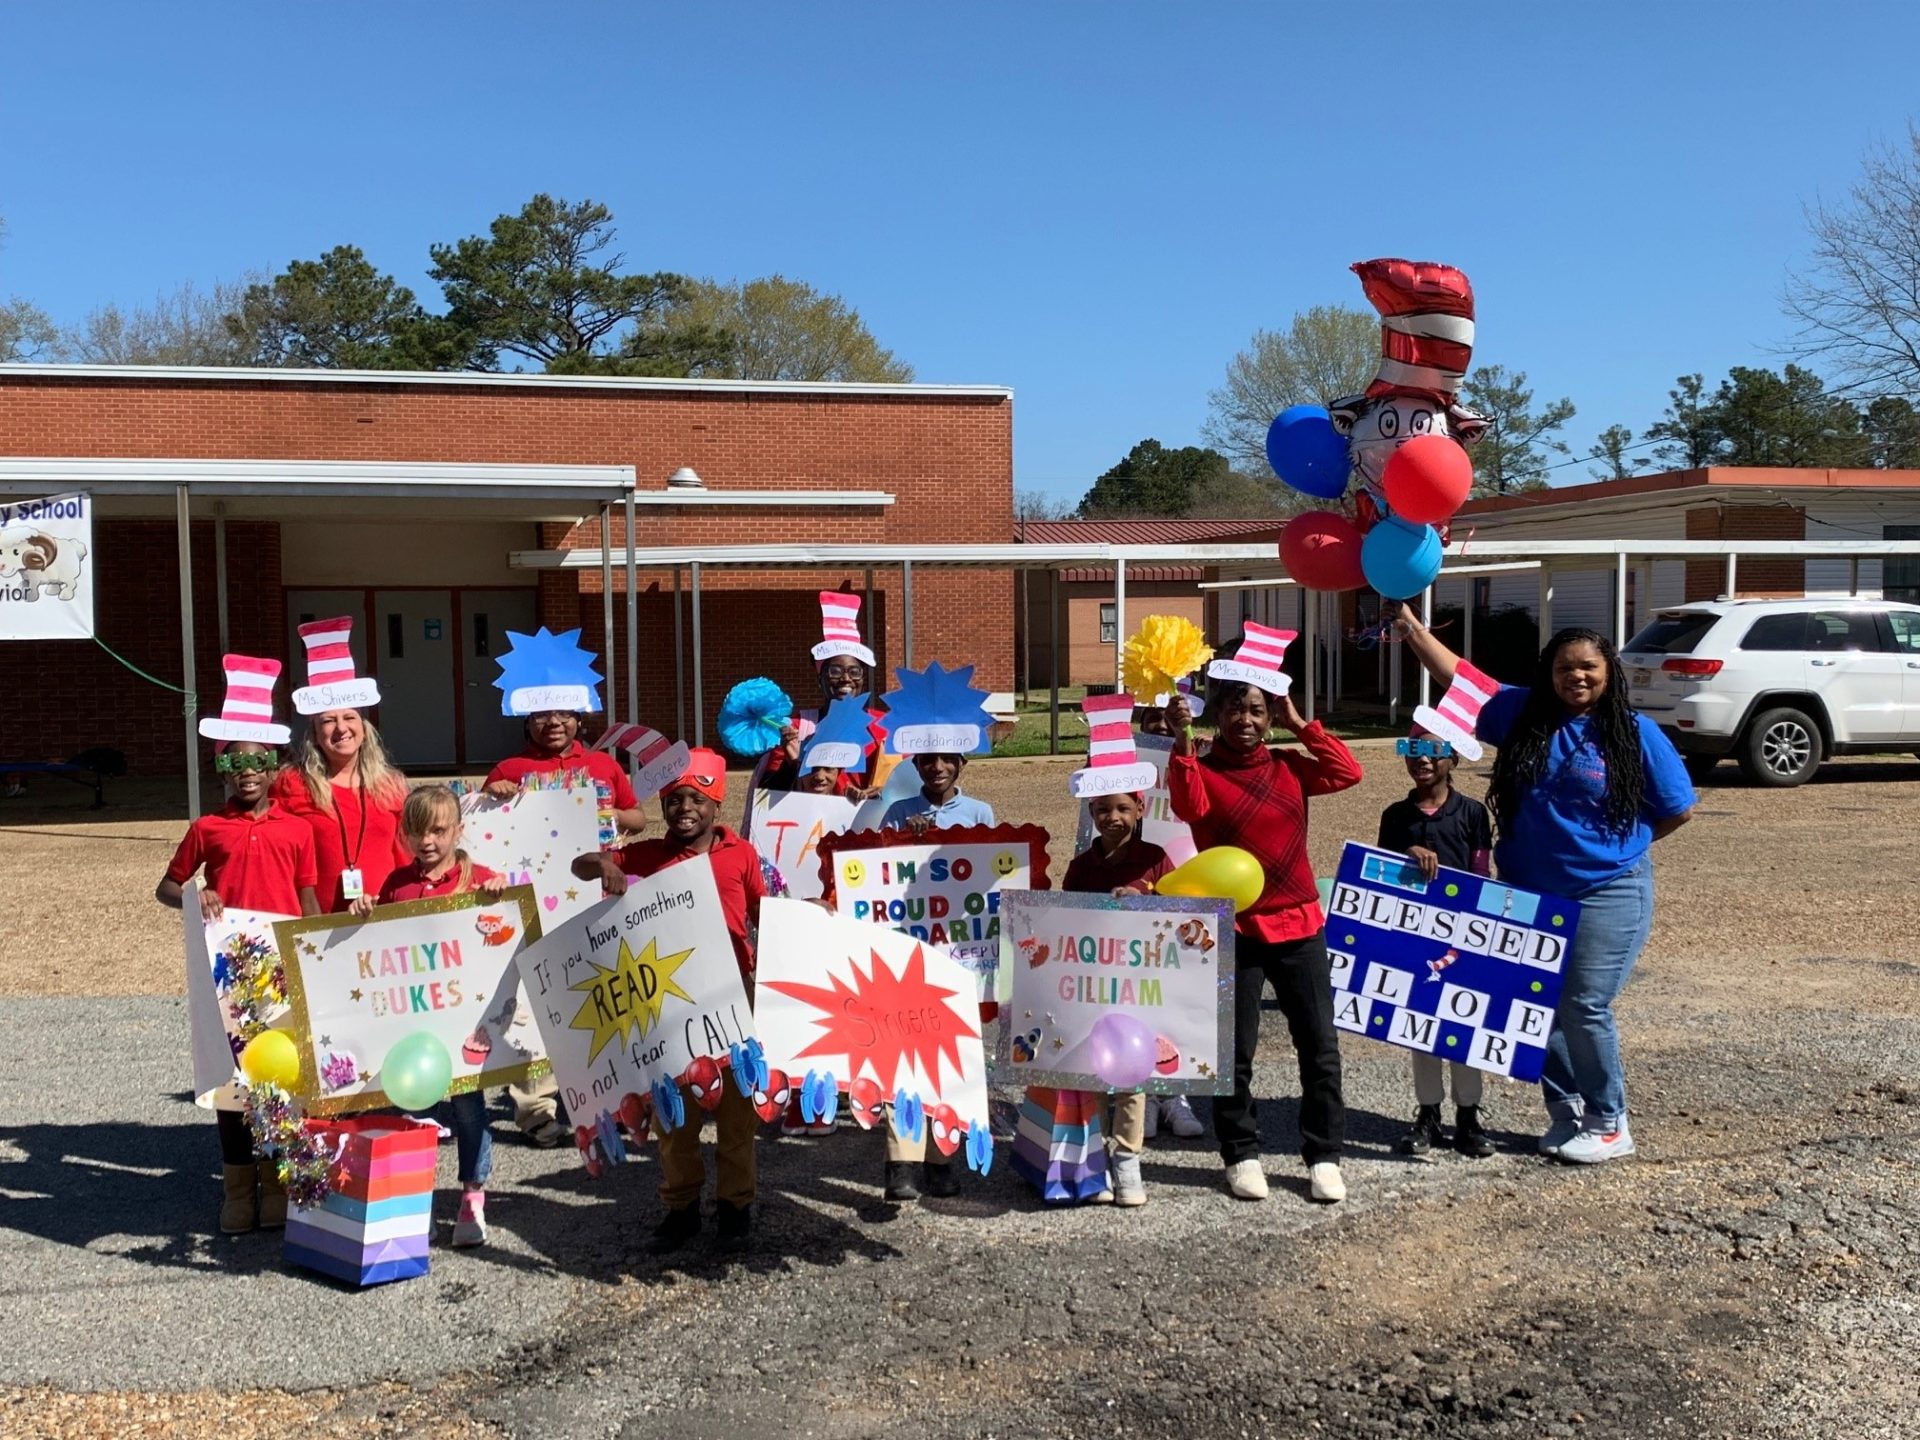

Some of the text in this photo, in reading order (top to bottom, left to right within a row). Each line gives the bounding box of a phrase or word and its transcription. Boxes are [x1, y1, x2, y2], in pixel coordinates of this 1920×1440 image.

[17, 495, 82, 519] School
[1245, 667, 1277, 687] Davis
[321, 687, 368, 706] Shivers
[901, 731, 973, 748] Freddarian
[817, 749, 848, 765] Taylor
[643, 756, 685, 791] Sincere
[930, 858, 973, 881] SO
[854, 892, 1000, 923] PROUD OF
[1333, 886, 1561, 963] BLESSED
[534, 890, 695, 995] If you have something
[950, 945, 987, 960] KEEP
[1052, 935, 1181, 969] JAQUESHA
[357, 939, 463, 979] KATLYN
[371, 979, 463, 1017] DUKES
[548, 963, 658, 1028] to READ
[1058, 975, 1163, 1006] GILLIAM
[843, 997, 942, 1048] Sincere
[566, 1087, 586, 1112] Do
[592, 1060, 620, 1099] not
[685, 1004, 750, 1059] CALL
